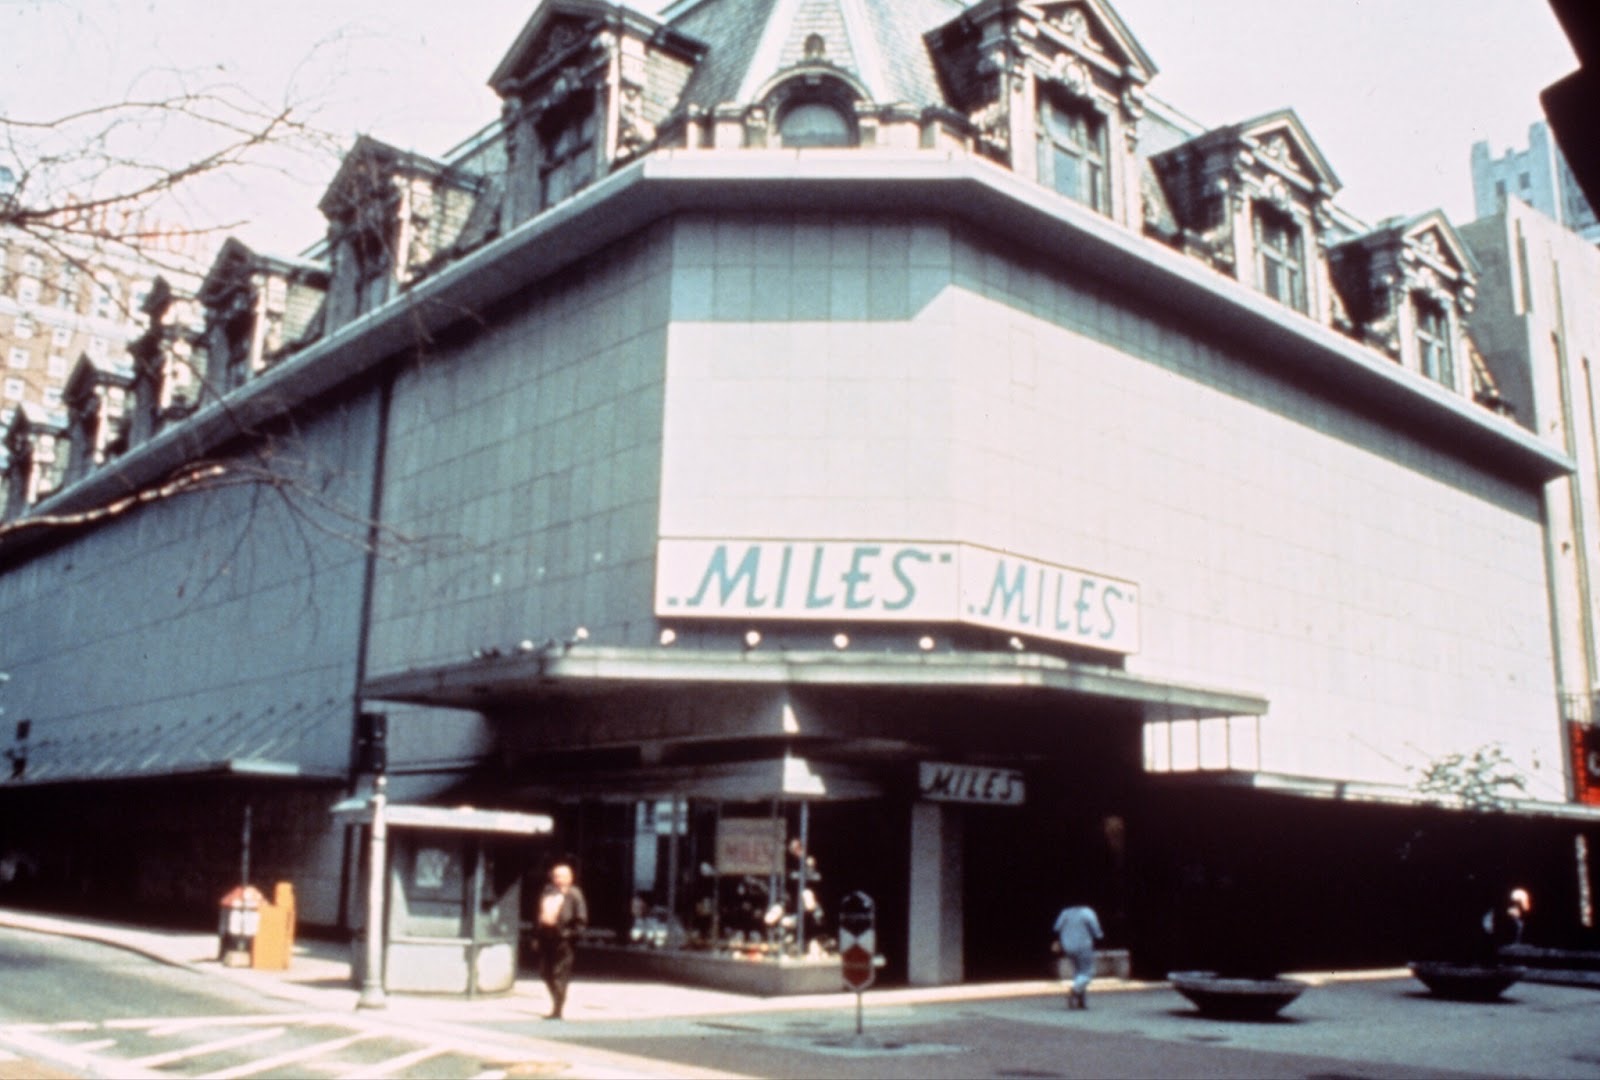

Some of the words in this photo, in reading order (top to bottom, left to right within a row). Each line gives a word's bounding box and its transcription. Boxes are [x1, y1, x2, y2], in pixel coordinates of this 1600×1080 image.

[685, 545, 932, 610] MILES
[981, 559, 1123, 640] MILES
[927, 767, 1024, 800] MILES
